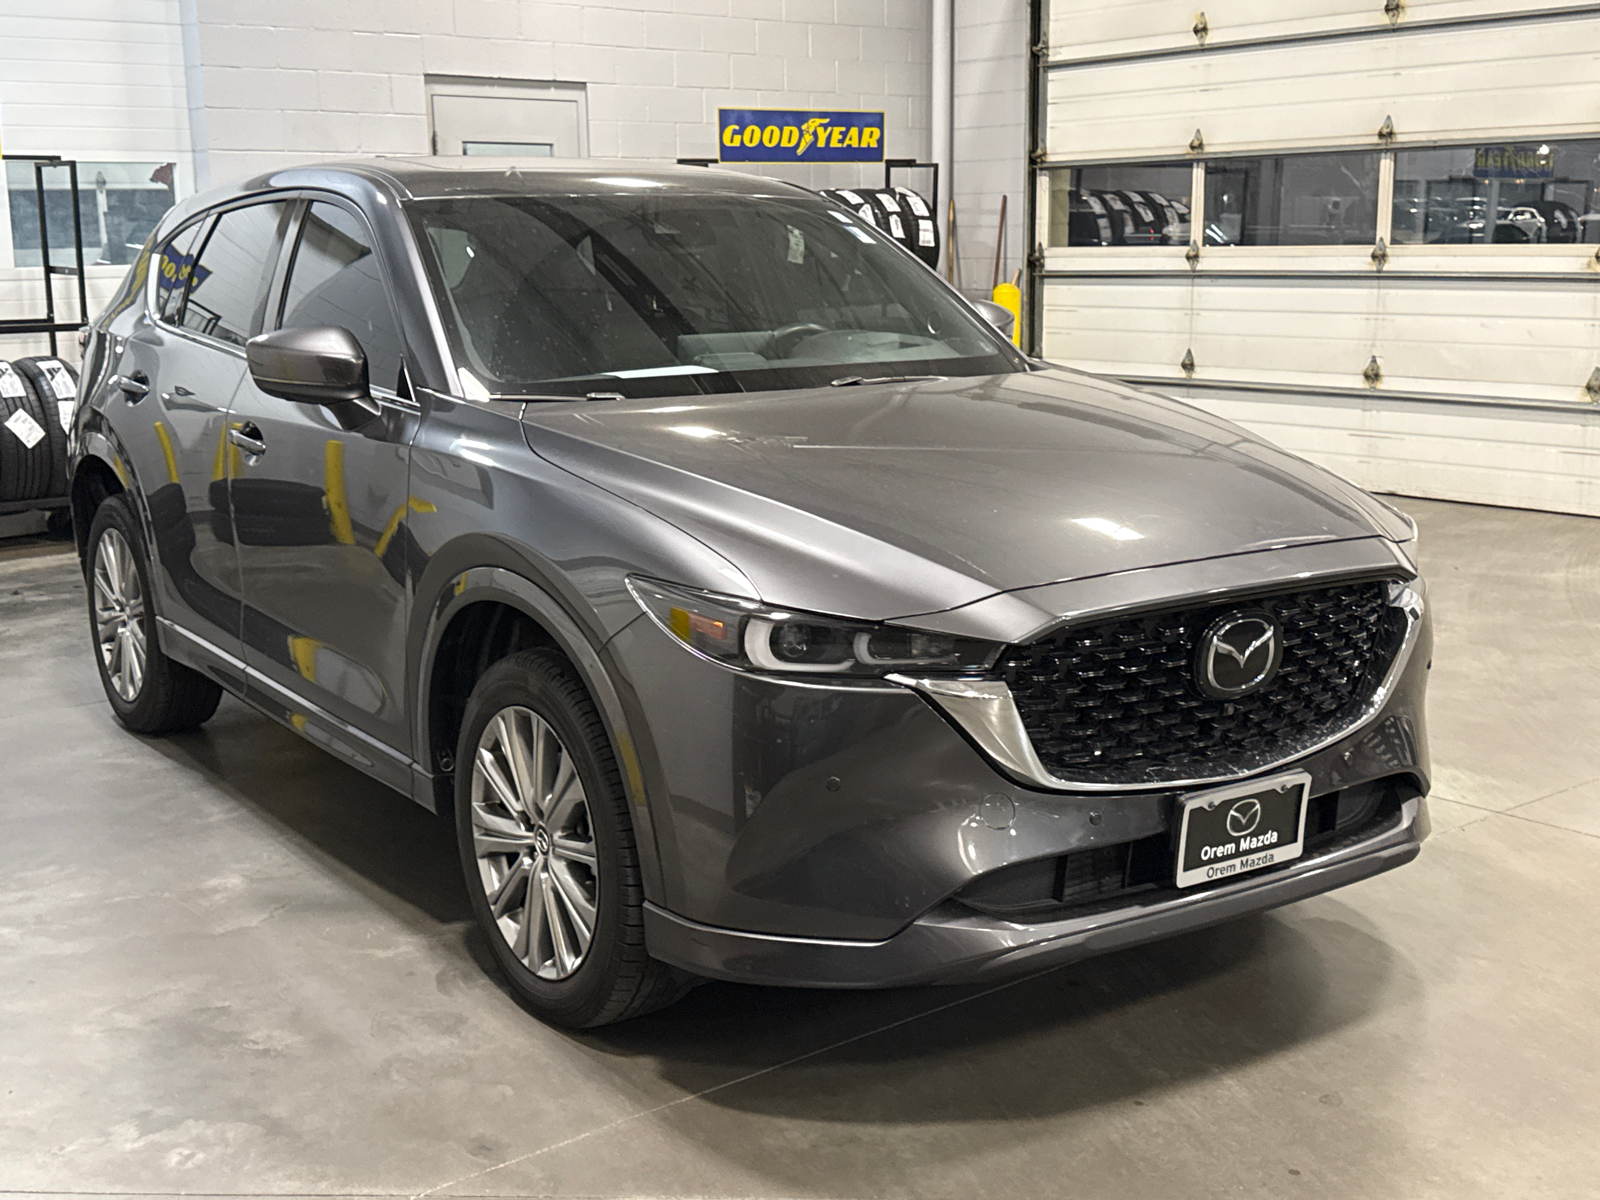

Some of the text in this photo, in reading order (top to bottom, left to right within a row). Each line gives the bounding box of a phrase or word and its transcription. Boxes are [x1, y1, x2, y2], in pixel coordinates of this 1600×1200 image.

[1201, 830, 1278, 860] Orem Mazda
[1206, 853, 1274, 878] Orem Mazda
